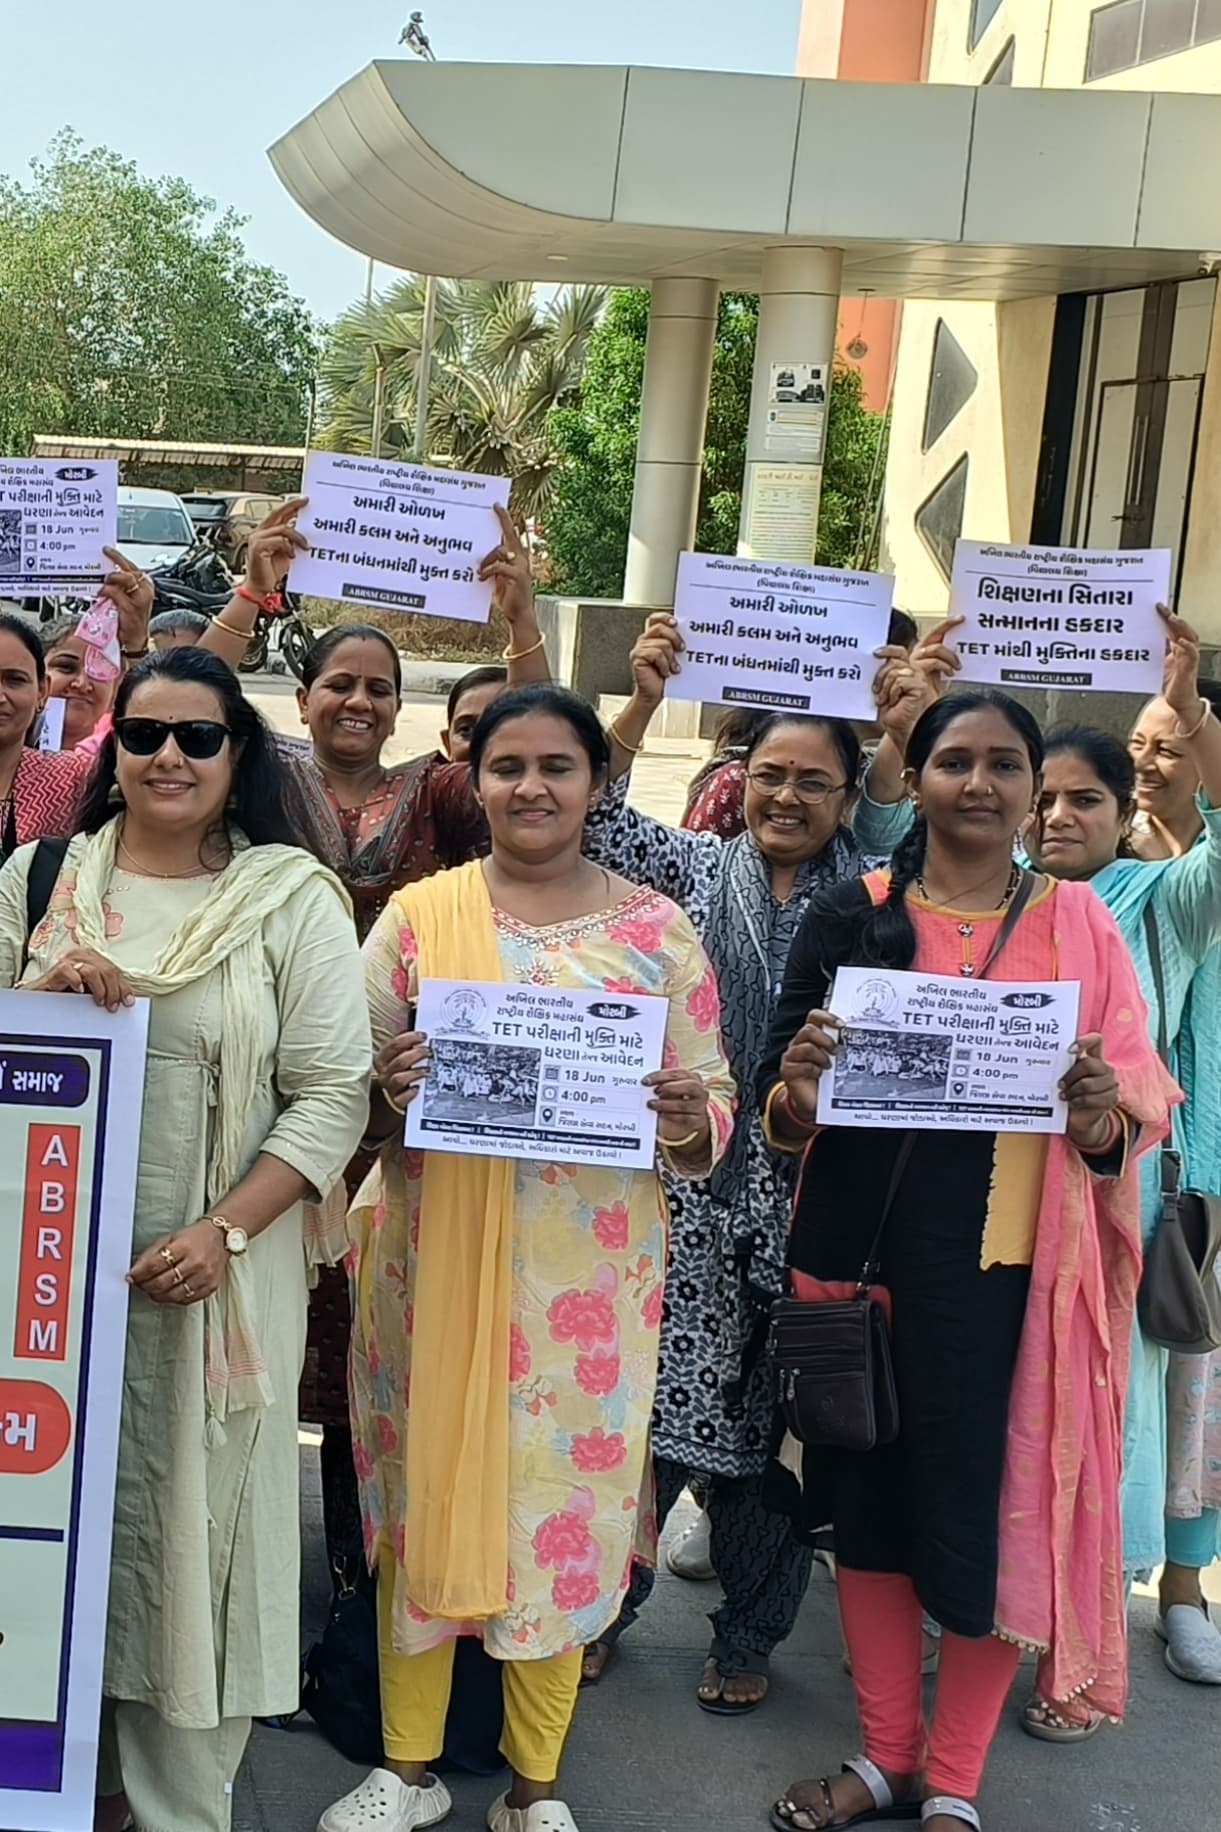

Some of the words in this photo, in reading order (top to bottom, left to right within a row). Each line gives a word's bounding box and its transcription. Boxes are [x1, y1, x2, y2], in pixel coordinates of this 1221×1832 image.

[353, 495, 396, 514] અમારી
[41, 525, 53, 535] 18
[55, 525, 75, 535] Jun
[313, 517, 356, 535] અમારી
[359, 524, 392, 540] કલમ
[395, 526, 420, 545] અને
[39, 541, 62, 551] 4:00
[977, 577, 1063, 605] શિક્ષણના
[1068, 583, 1133, 606] સિતારા
[729, 595, 775, 613] અમારી
[689, 619, 734, 637] અમારી
[737, 625, 772, 641] કલમ
[775, 626, 801, 645] અને
[1064, 616, 1125, 634] હકદાર
[957, 641, 990, 656] TET
[1099, 648, 1150, 663] હકદાર
[902, 1011, 934, 1027] TET
[1035, 1018, 1060, 1035] માટે
[492, 1021, 523, 1037] TET
[619, 1032, 644, 1049] માટે
[977, 1052, 992, 1062] 18
[994, 1053, 1019, 1064] Jun
[12, 1069, 64, 1093] સમાજ
[565, 1069, 580, 1082] 18
[582, 1071, 606, 1084] Jun
[972, 1068, 1001, 1078] 4:00
[1002, 1072, 1020, 1081] pm
[561, 1090, 589, 1103] 4:00
[590, 1096, 606, 1105] pm
